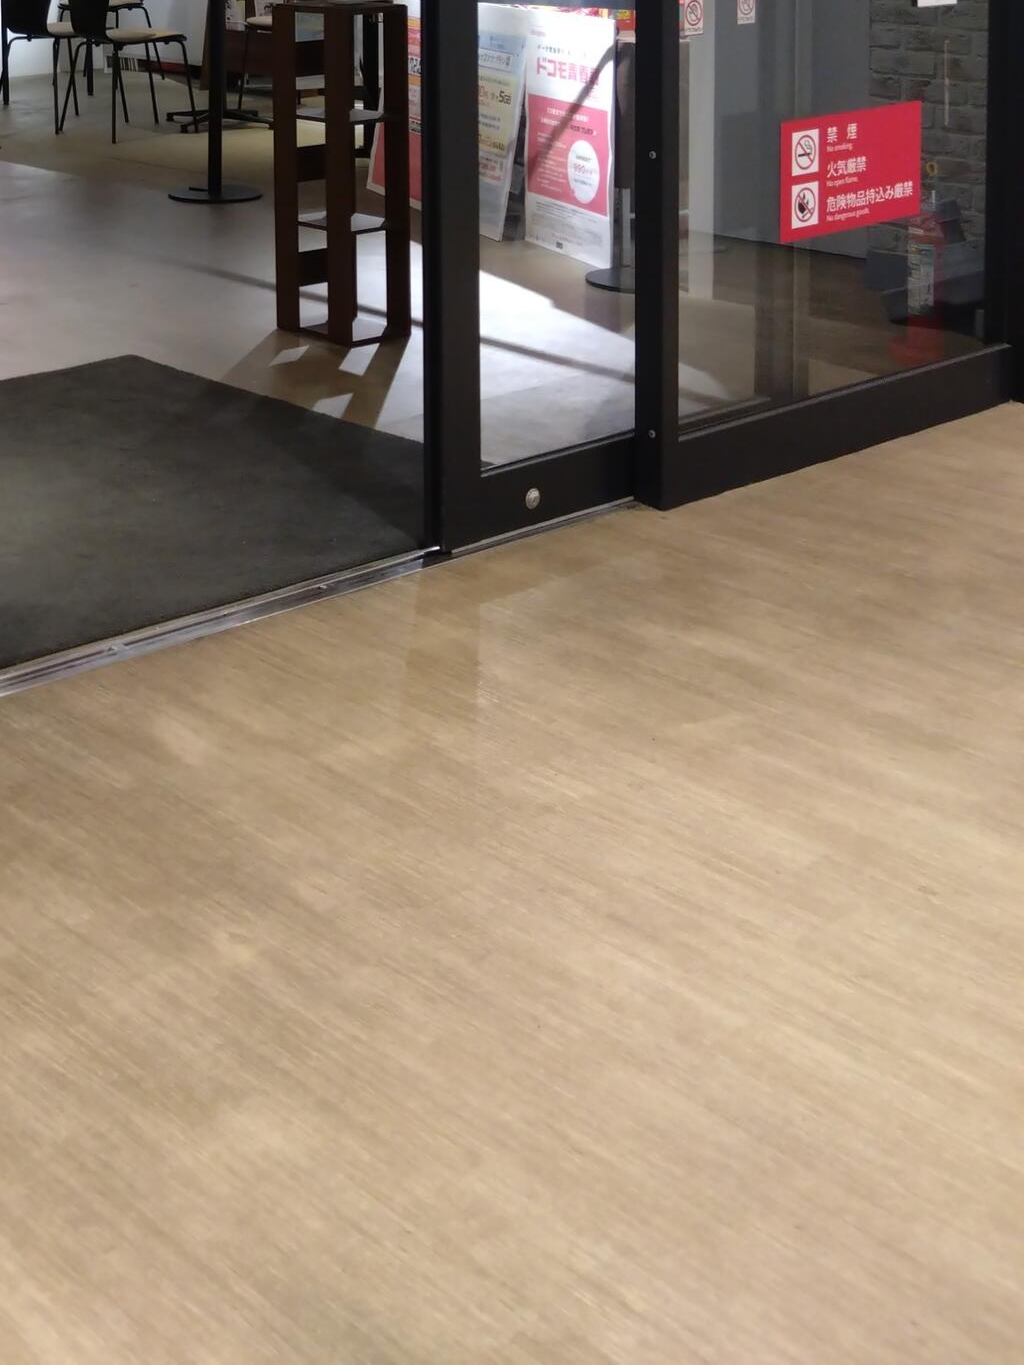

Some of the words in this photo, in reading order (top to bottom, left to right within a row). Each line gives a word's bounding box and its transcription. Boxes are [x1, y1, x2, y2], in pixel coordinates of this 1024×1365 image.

[827, 156, 866, 178] 火気厳禁
[826, 181, 913, 212] 危険物品持込み厳禁
